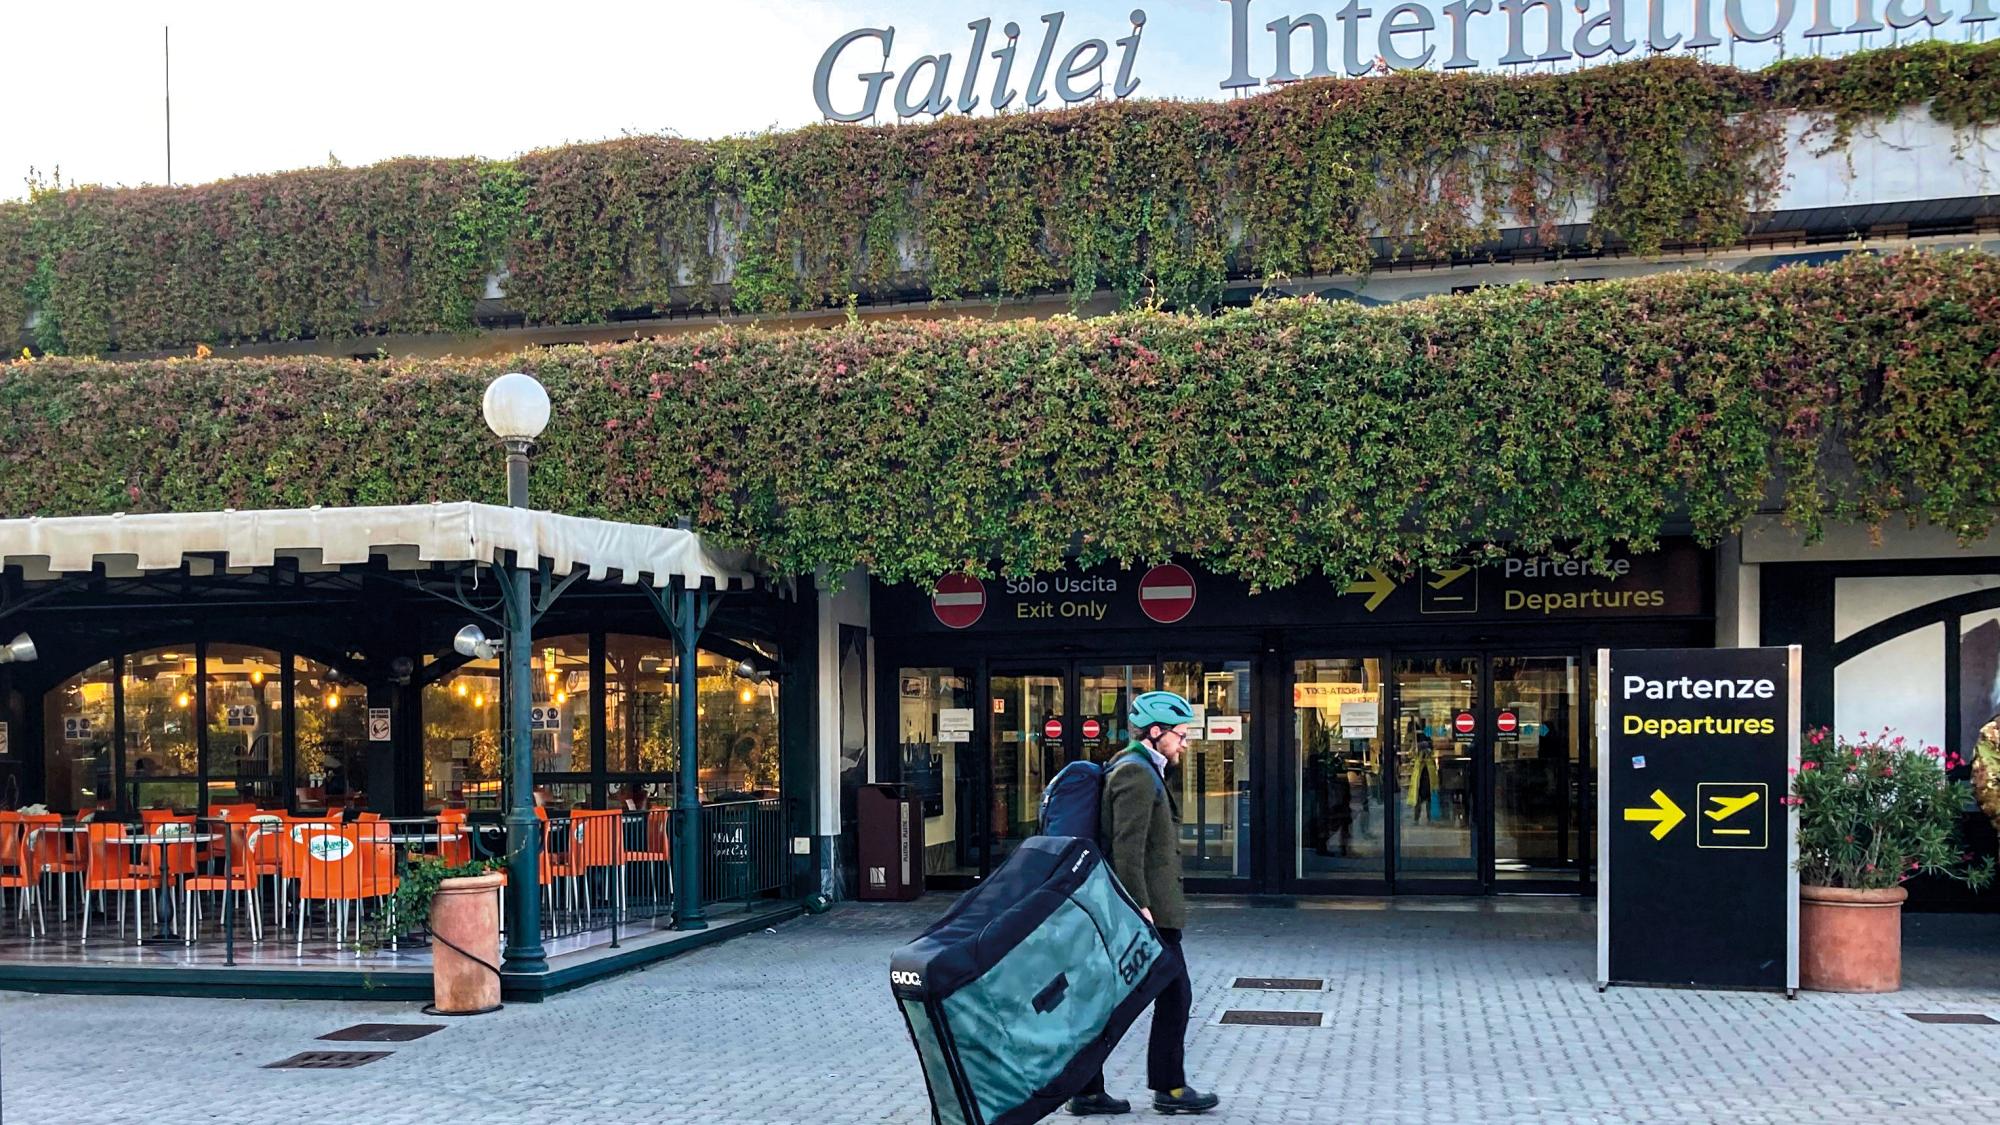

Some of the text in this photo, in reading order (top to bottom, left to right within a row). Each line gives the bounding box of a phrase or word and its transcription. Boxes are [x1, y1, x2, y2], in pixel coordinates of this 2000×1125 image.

[813, 0, 1998, 122] Galilei Internaton
[1006, 575, 1117, 594] Solo Uscita
[1017, 600, 1107, 620] Exit Only
[1505, 589, 1665, 614] Departures
[1623, 675, 1775, 700] Partenze
[1623, 715, 1775, 739] Departures
